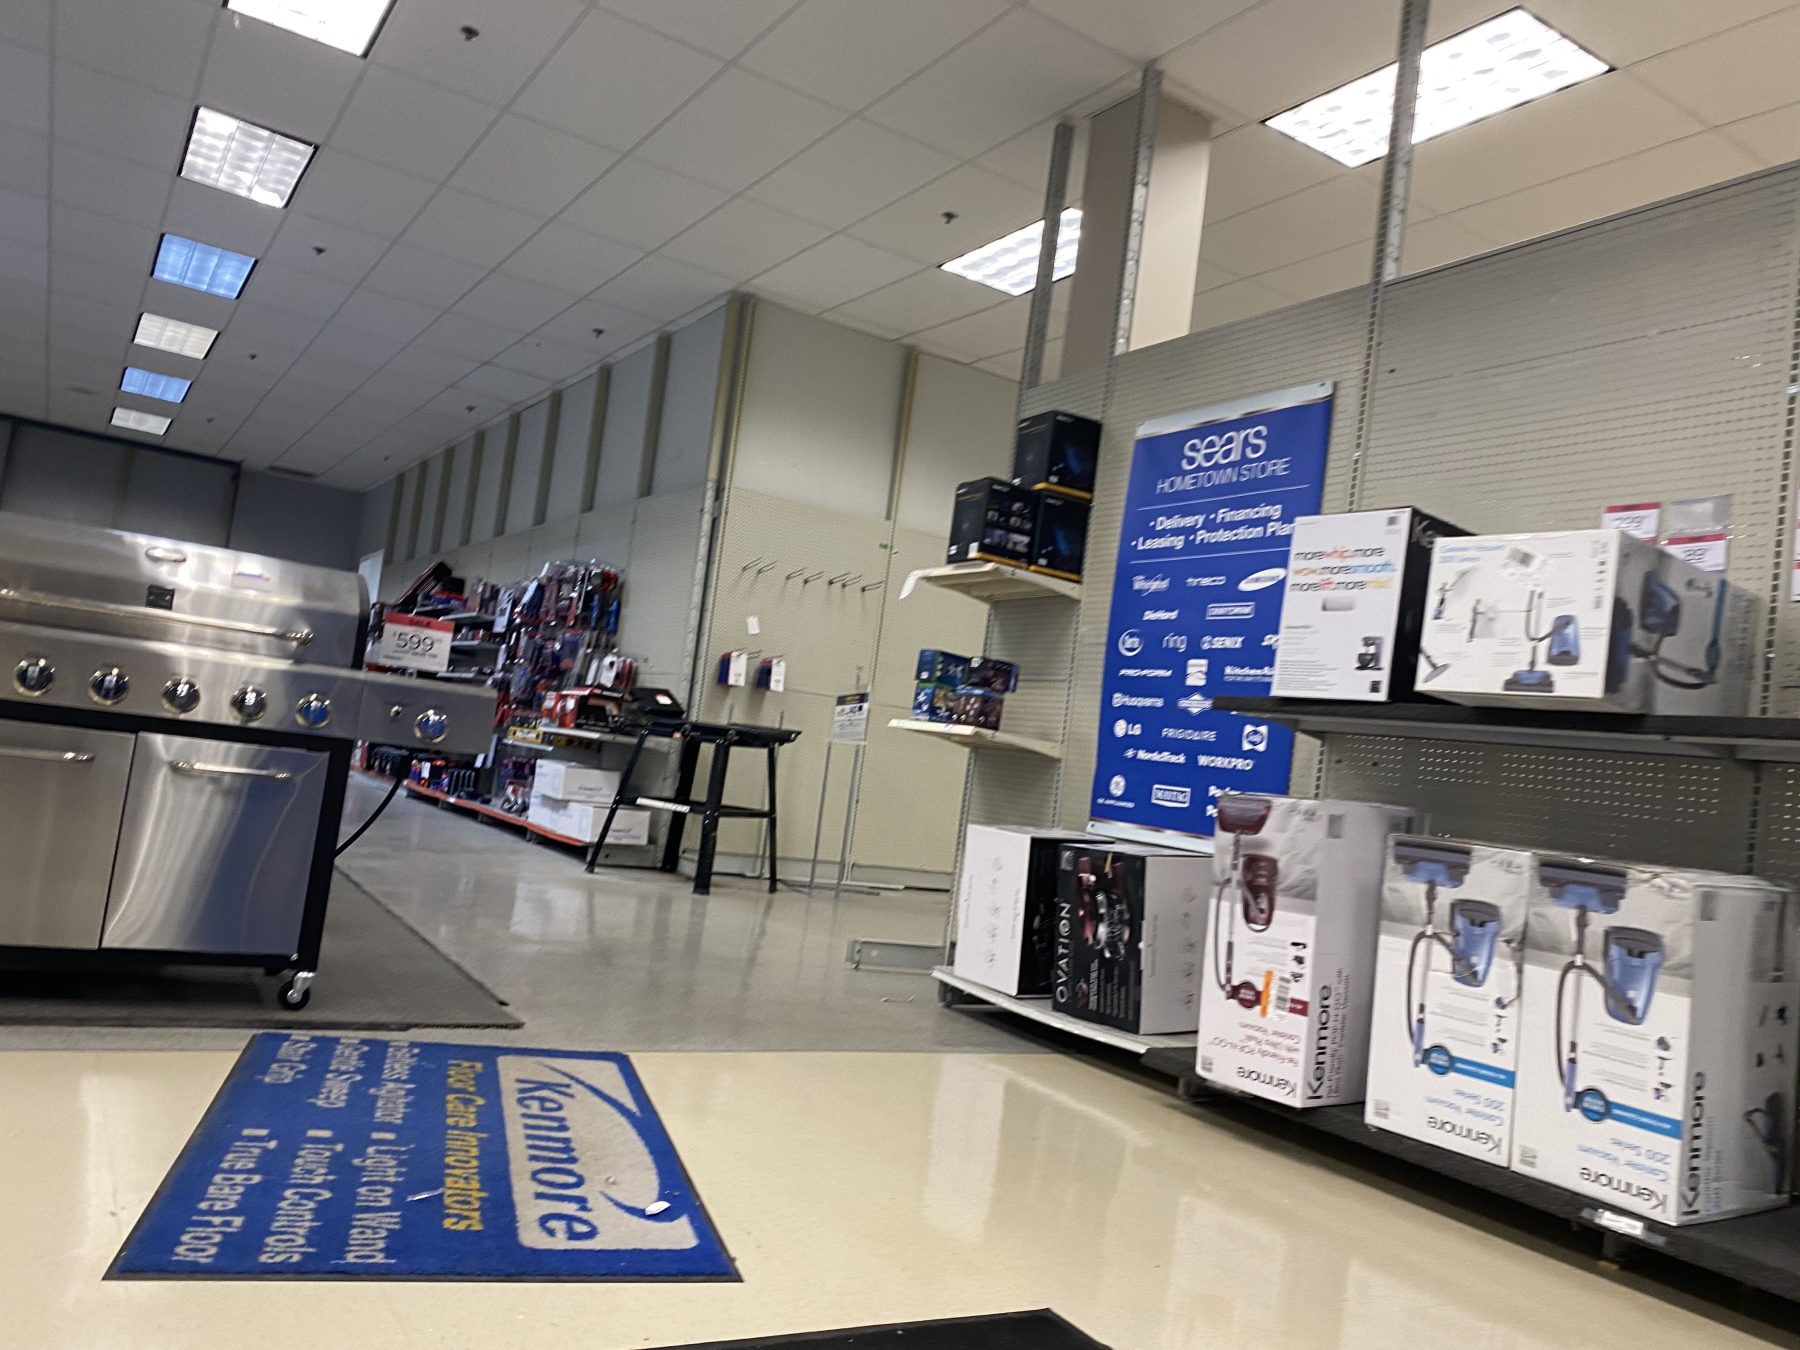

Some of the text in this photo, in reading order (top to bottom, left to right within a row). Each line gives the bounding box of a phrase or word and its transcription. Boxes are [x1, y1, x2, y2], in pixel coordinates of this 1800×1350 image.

[1181, 425, 1268, 471] sears
[1155, 457, 1292, 494] HOMETOWN STORE
[1137, 534, 1185, 551] Leasing
[1195, 524, 1264, 546] Protection
[1155, 503, 1282, 532] Delivery Financing
[1127, 723, 1142, 736] LG
[1197, 754, 1256, 771] WORKPRO
[1055, 902, 1073, 1003] OVATION
[1306, 985, 1332, 1100] Kenmore
[1236, 1065, 1298, 1098] Kenmore
[439, 1060, 487, 1232] Floor Care Innovators
[514, 1077, 602, 1243] Kenmore
[1426, 1115, 1503, 1156] Kenmore
[1681, 1071, 1707, 1216] Kenmore
[172, 1139, 278, 1263] True Bare Floor
[258, 1143, 344, 1263] Touch Controls
[346, 1145, 415, 1264] Light on Wand
[1578, 1166, 1669, 1215] Kenmore
